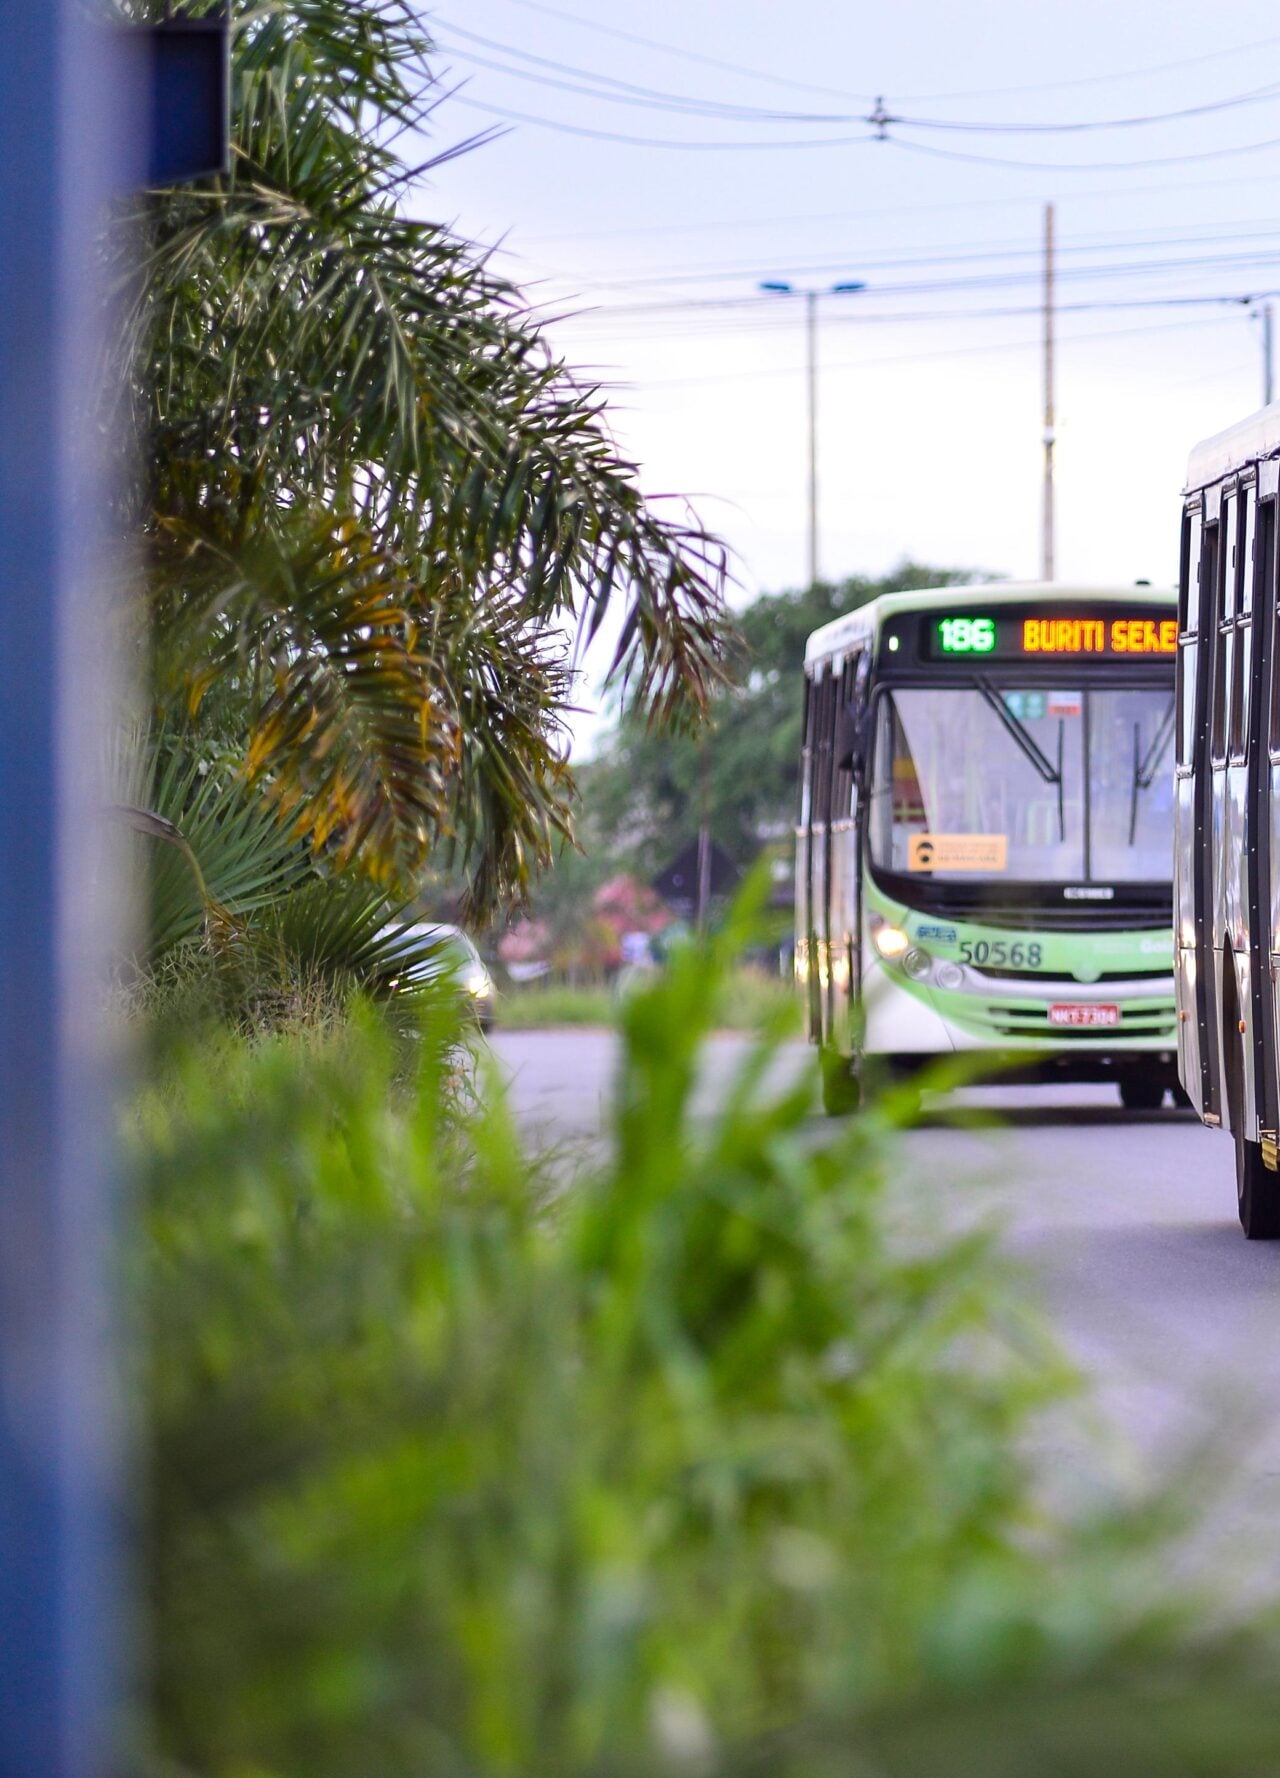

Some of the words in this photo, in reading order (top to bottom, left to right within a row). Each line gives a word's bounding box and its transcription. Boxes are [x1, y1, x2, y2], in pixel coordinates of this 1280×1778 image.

[939, 618, 995, 652] 186
[1023, 619, 1105, 652] BURITI
[960, 941, 1042, 967] 50568
